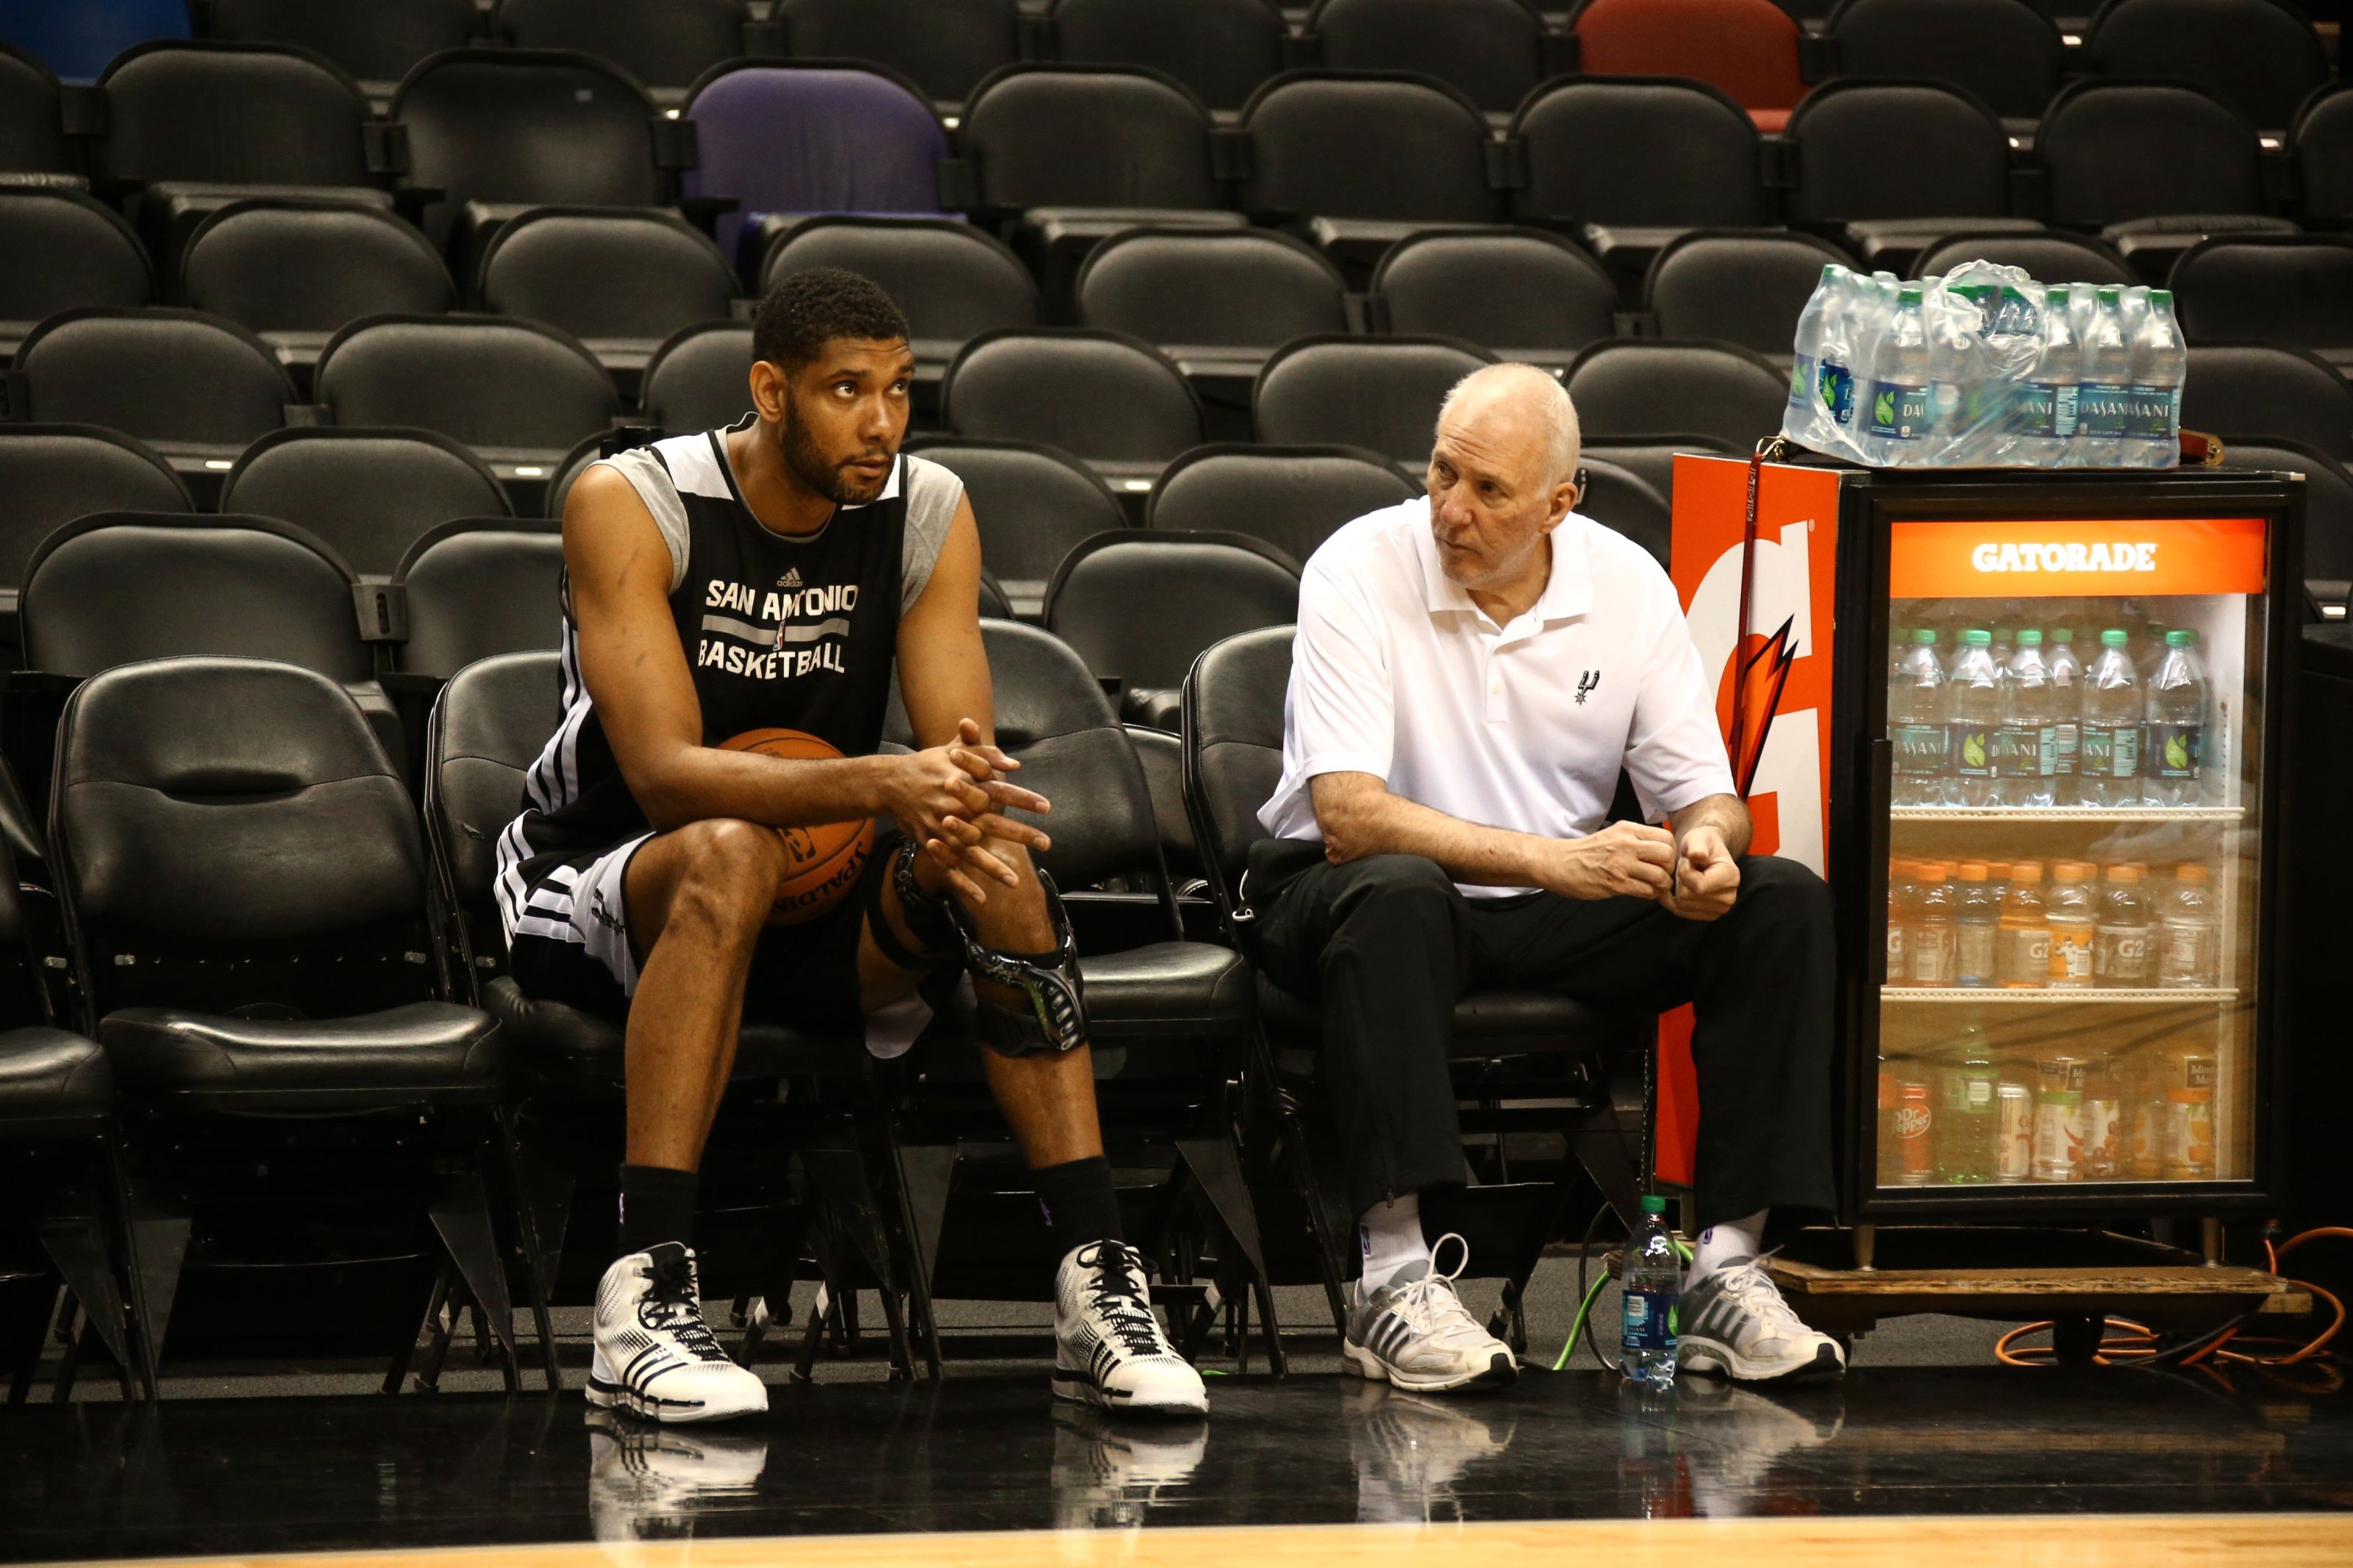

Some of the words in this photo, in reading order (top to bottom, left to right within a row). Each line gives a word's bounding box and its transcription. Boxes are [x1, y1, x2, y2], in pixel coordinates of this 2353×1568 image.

[2080, 399, 2128, 418] DASAN
[2129, 400, 2169, 419] SANI
[1972, 543, 2157, 572] GATORADE
[776, 579, 803, 587] adidas
[705, 579, 756, 616] SAN
[762, 584, 859, 621] ANTONIO
[698, 639, 845, 680] BASKETBALL
[2118, 939, 2145, 959] G2
[1903, 1108, 1919, 1122] Dr
